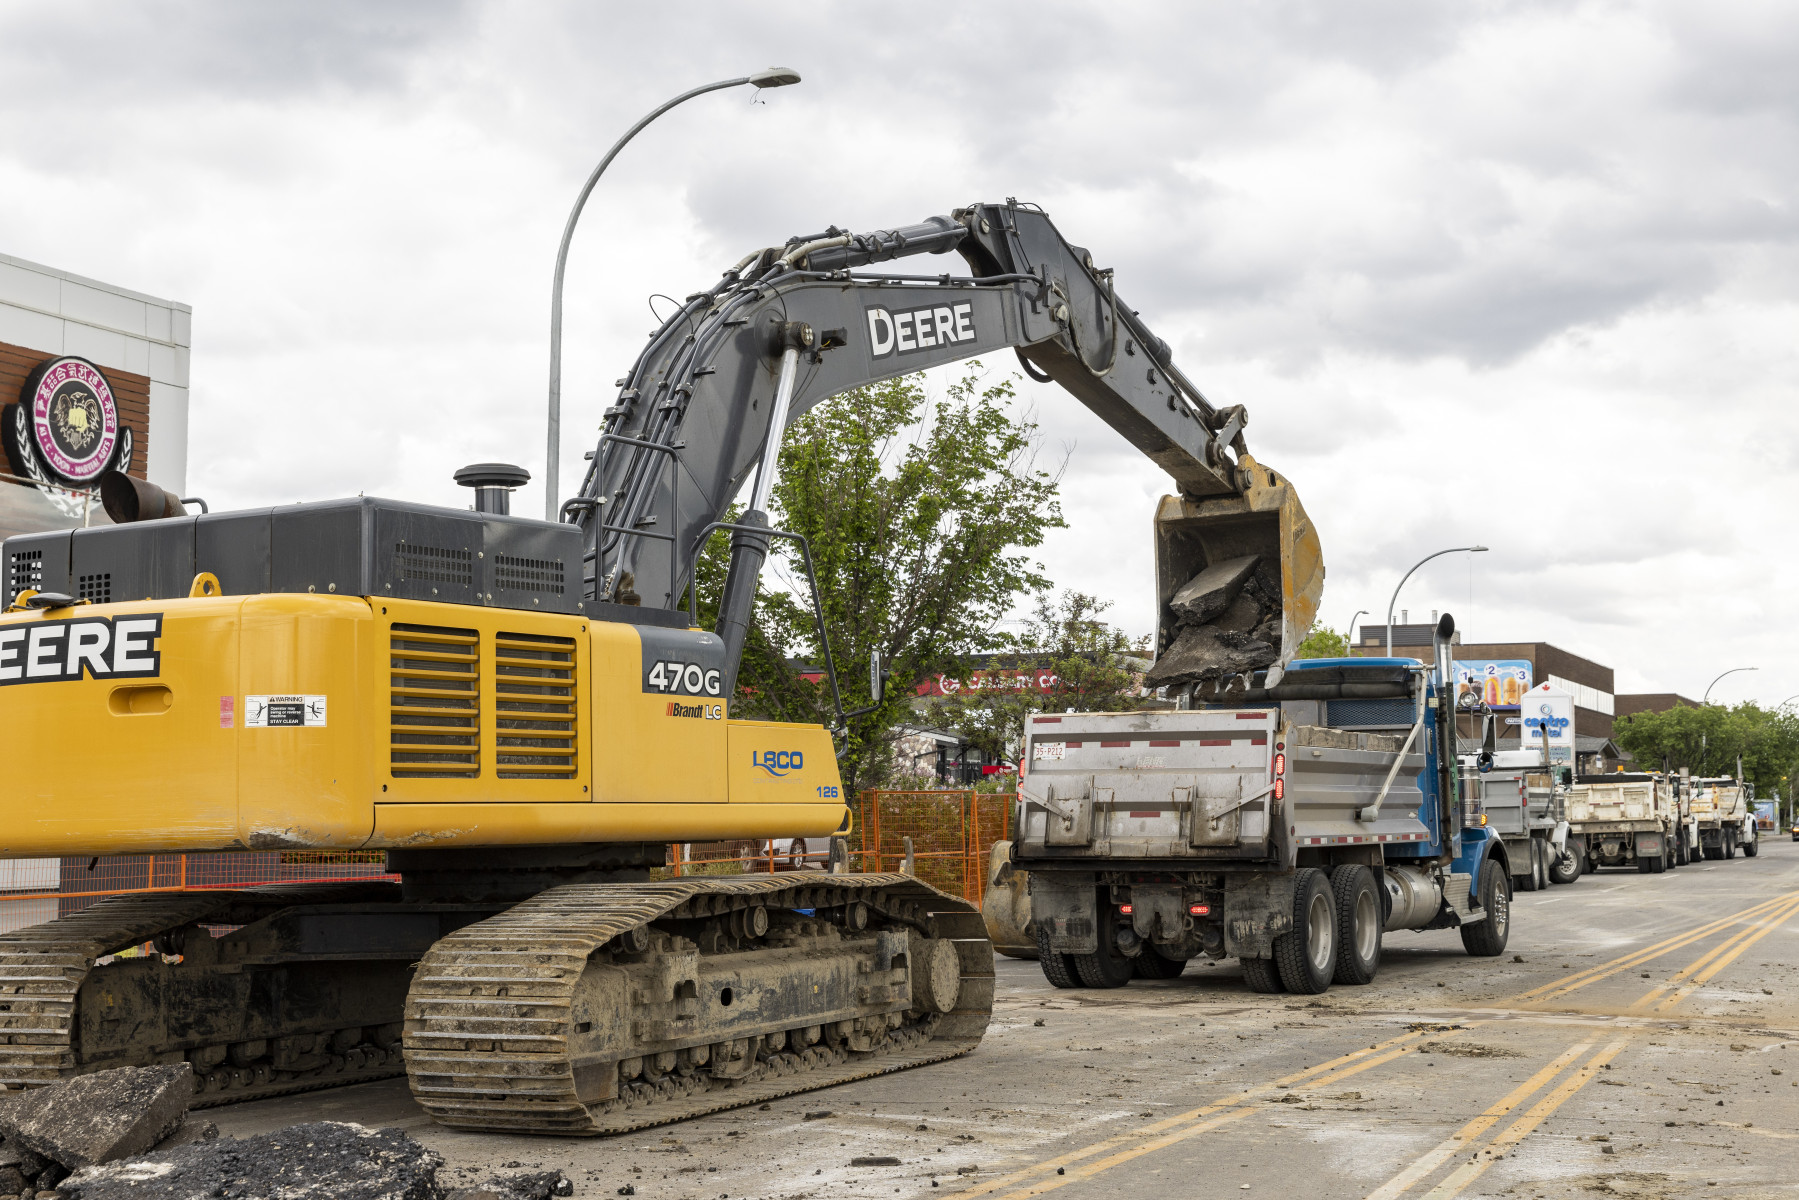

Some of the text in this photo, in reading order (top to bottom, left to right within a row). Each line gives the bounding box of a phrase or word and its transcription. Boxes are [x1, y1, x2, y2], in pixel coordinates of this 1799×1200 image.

[867, 303, 975, 356] DEERE
[98, 440, 111, 459] ARTS
[648, 661, 721, 696] 470G
[673, 702, 722, 720] Brandt LC
[1524, 715, 1569, 728] centro
[1531, 727, 1562, 738] mtel
[1035, 747, 1063, 756] 35-P212
[816, 786, 839, 798] 126
